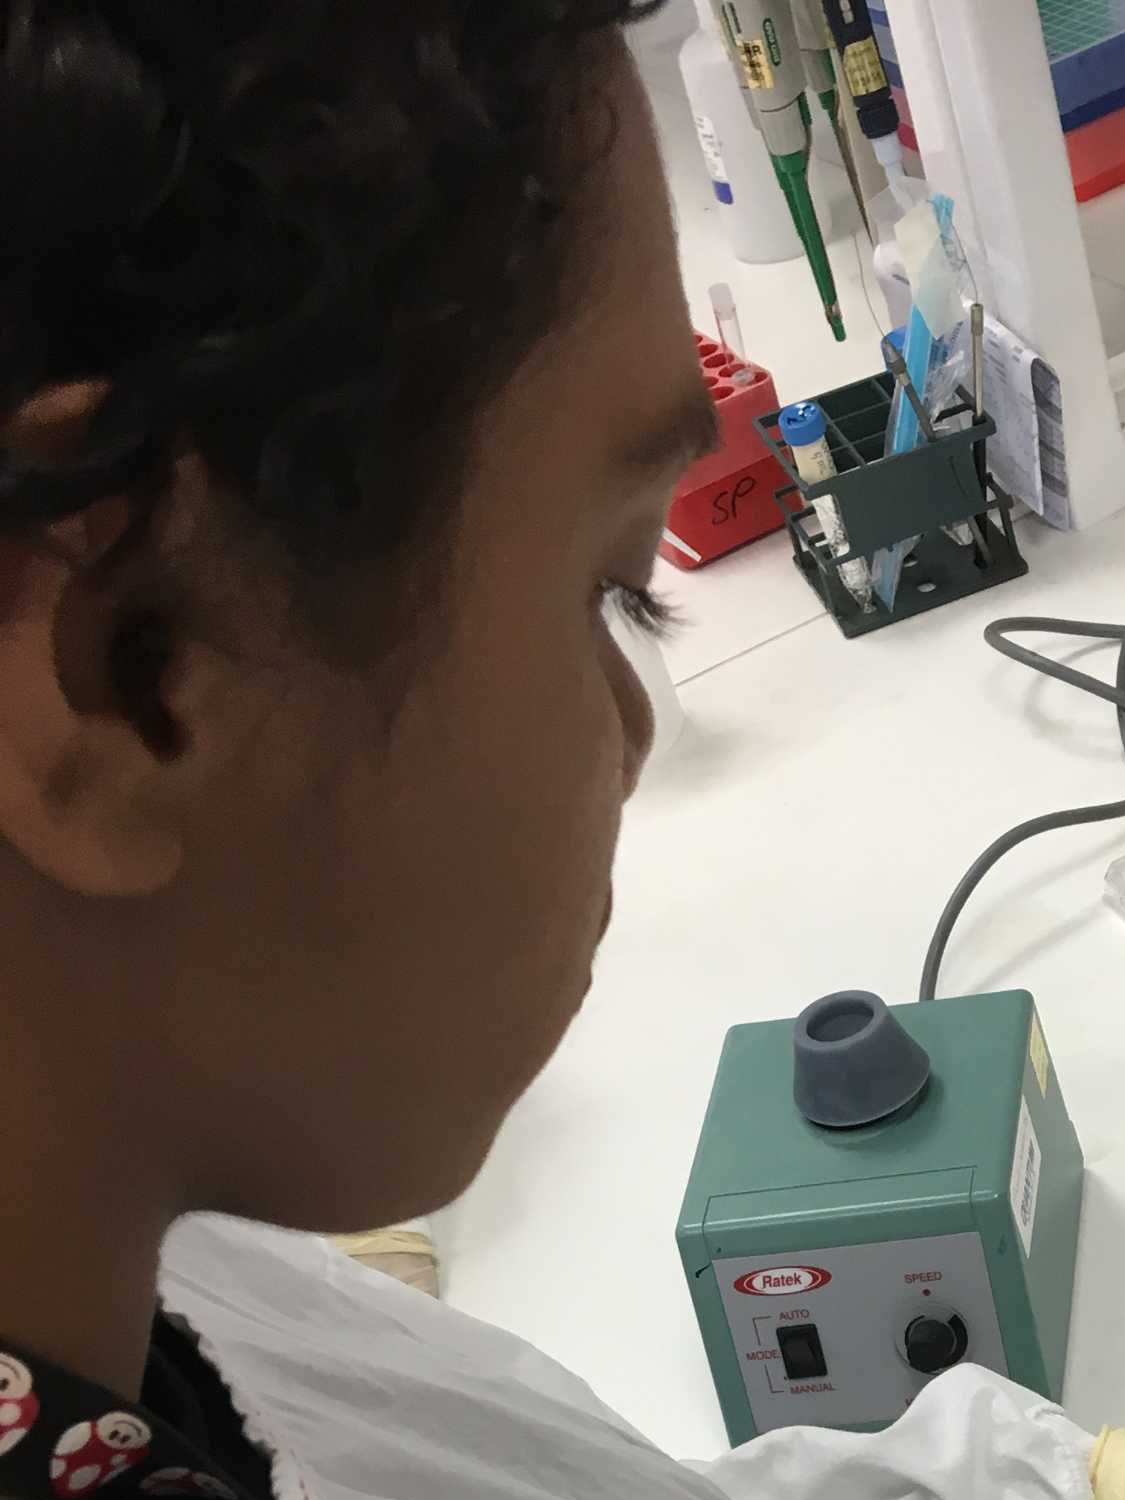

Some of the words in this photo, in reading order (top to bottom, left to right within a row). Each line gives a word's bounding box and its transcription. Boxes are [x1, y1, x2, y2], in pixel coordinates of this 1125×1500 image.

[712, 475, 757, 526] SP
[762, 1273, 803, 1289] Ratek
[904, 1271, 943, 1284] SPEED
[779, 1309, 810, 1321] AUTO
[747, 1349, 780, 1361] MODE
[790, 1382, 835, 1394] MANUAL
